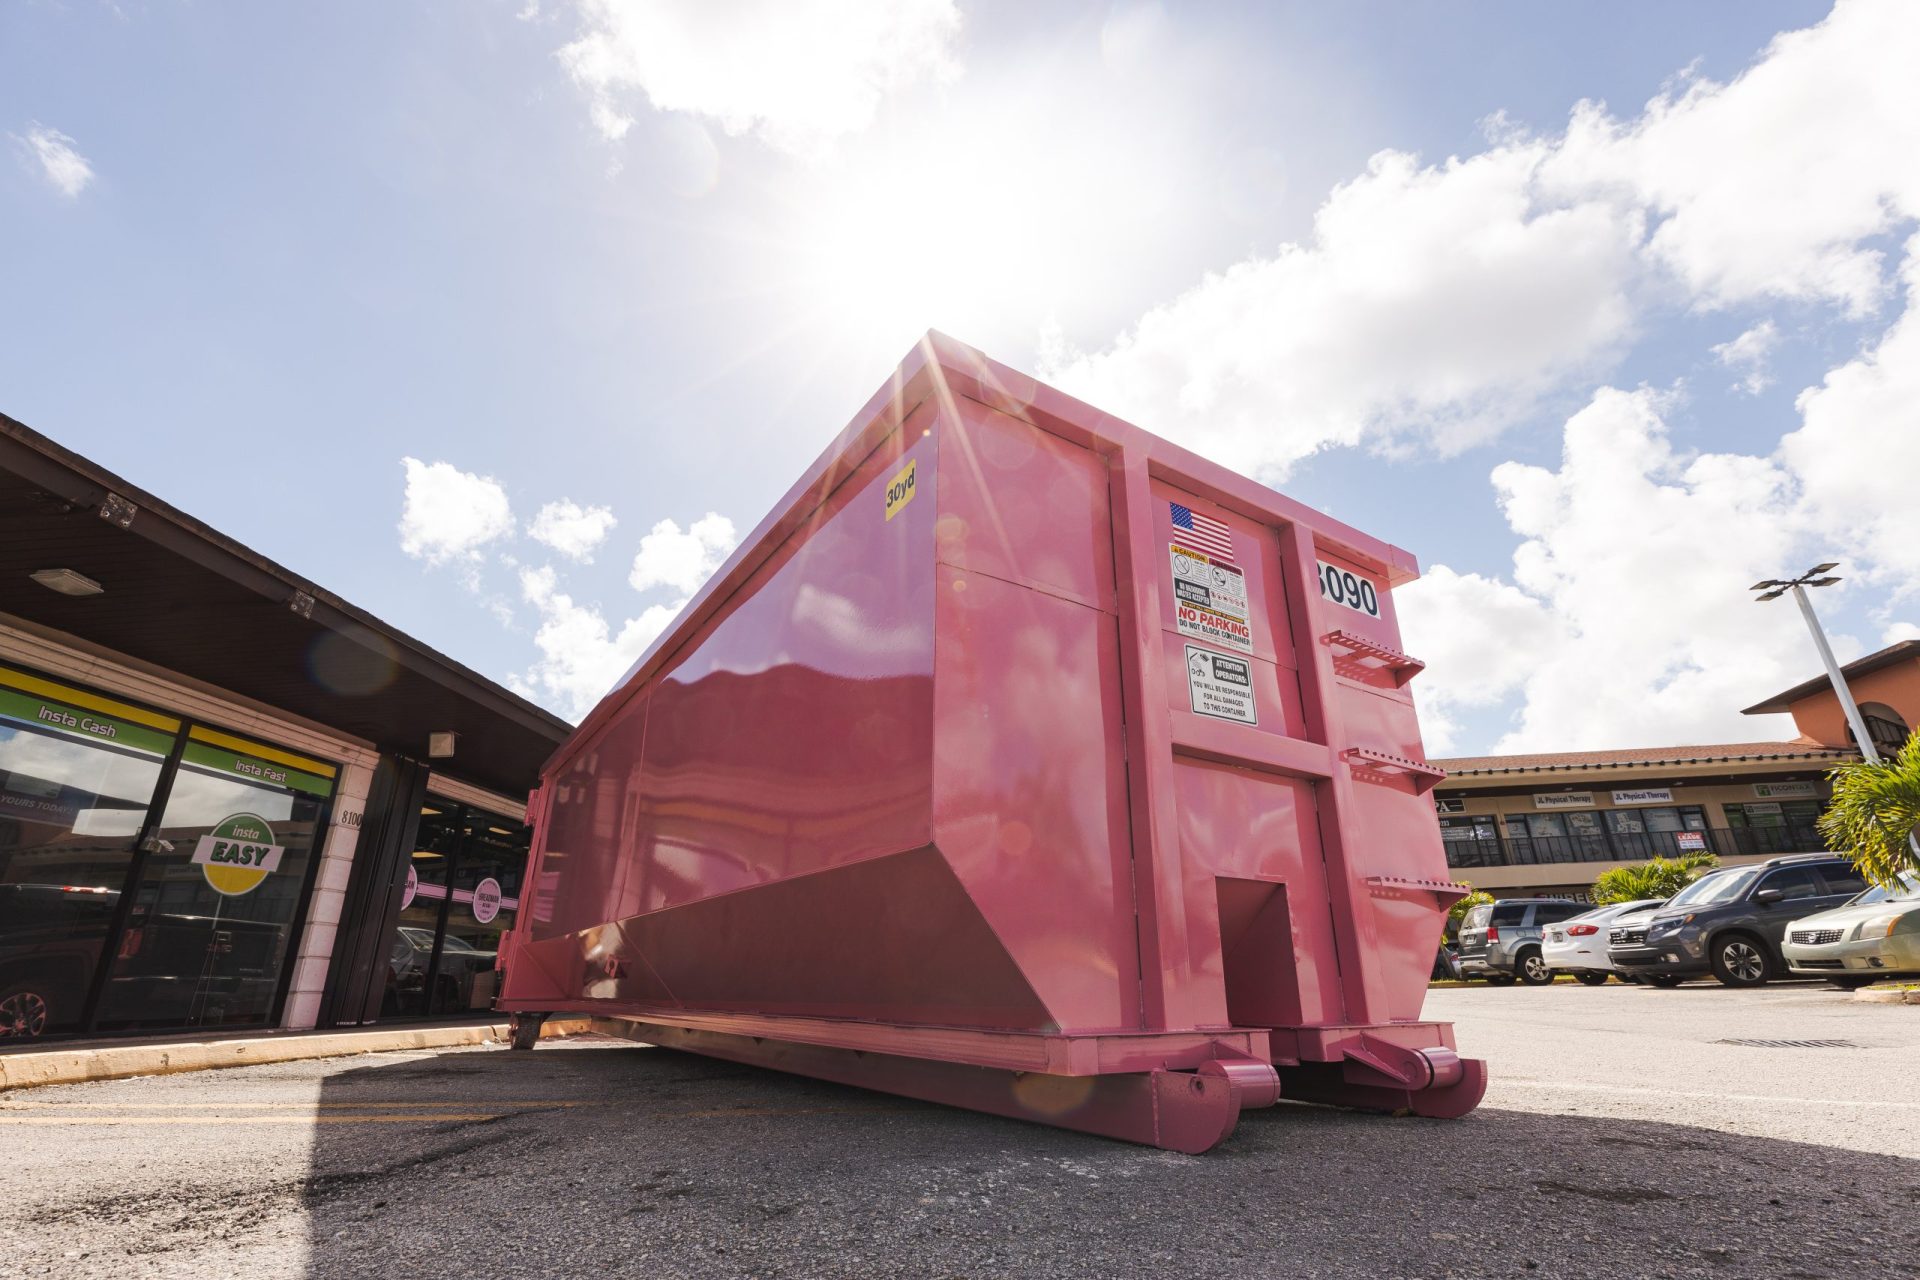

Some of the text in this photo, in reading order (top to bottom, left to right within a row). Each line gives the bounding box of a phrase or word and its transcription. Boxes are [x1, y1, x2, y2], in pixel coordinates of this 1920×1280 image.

[887, 467, 915, 508] 30yd
[1317, 562, 1377, 616] 090
[1179, 607, 1197, 621] NO
[1200, 612, 1249, 638] PARKING
[1179, 619, 1188, 627] DO
[1189, 622, 1201, 631] NOT
[1202, 625, 1221, 637] BLOCK
[1221, 631, 1251, 646] CONTAINER
[1216, 659, 1244, 673] ATTENTION
[1193, 680, 1251, 699] YOU WILL BE RESPONSIBLE
[1203, 692, 1244, 707] FOR ALL DAMAGES
[1203, 702, 1246, 717] TO THIS CONTAINER
[38, 705, 117, 737] Insta Cash
[235, 759, 287, 783] Insta Fast
[1545, 796, 1568, 804] Physical
[1569, 795, 1592, 803] Therapy
[1623, 792, 1646, 801] Physical
[1646, 791, 1670, 800] Therapy
[341, 810, 363, 827] 8100
[232, 824, 260, 840] insta
[210, 841, 271, 866] EASY
